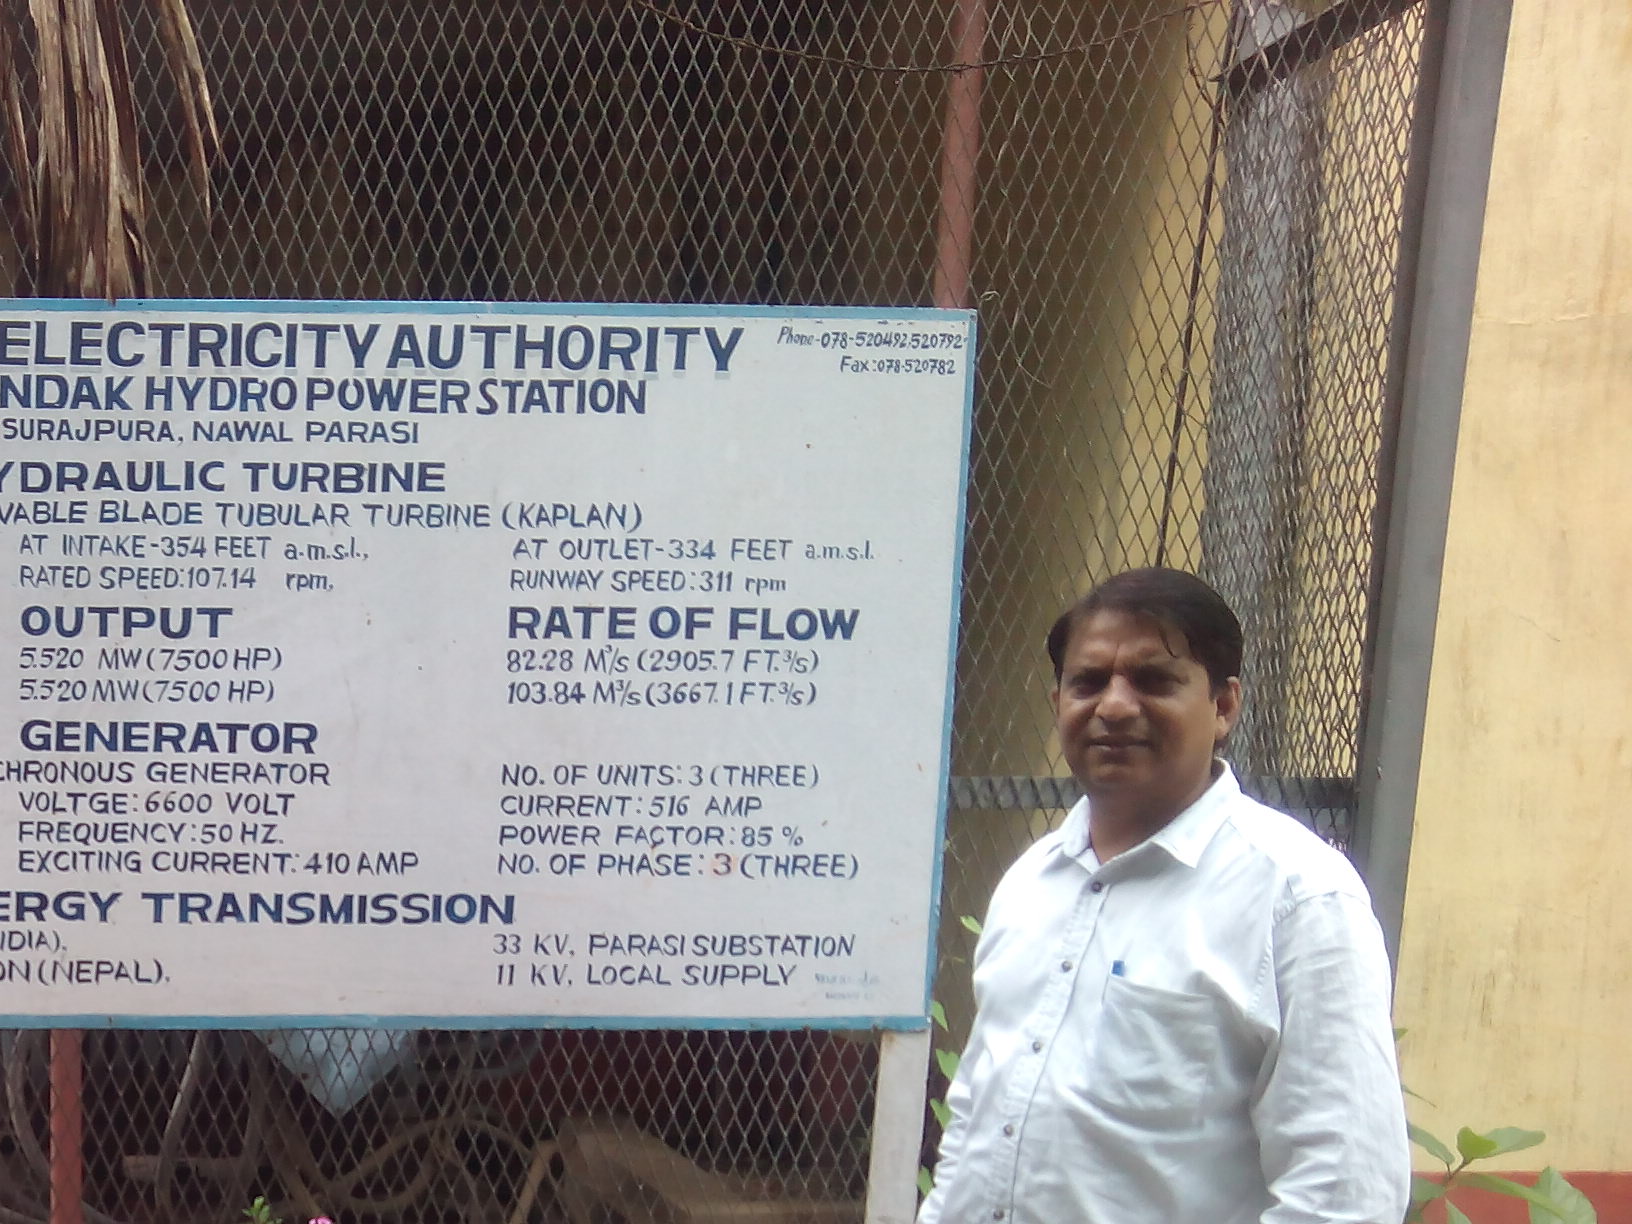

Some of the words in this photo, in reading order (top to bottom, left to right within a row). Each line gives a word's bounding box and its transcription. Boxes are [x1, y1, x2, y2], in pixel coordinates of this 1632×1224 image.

[386, 324, 745, 372] AUTHORITY
[145, 376, 297, 412] HYDRO
[306, 377, 471, 414] POWER
[475, 378, 647, 415] STATION
[192, 420, 294, 443] NAWAL
[306, 421, 419, 444] PARASI
[243, 462, 446, 494] TURBINE
[99, 500, 204, 526] BLADE
[215, 502, 351, 528] TUBULAR
[362, 502, 491, 529] TURBINE
[501, 501, 643, 533] (KAPLAN)
[19, 533, 48, 556] AT
[214, 536, 272, 560] FEET
[512, 538, 548, 561] AT
[730, 538, 794, 561] FEET
[19, 565, 92, 589] RATED
[509, 569, 605, 593] RUNWAY
[745, 575, 788, 597] rpm
[20, 605, 234, 640] OUTPUT
[508, 605, 639, 641] RATE
[648, 605, 715, 641] OF
[729, 607, 862, 641] FLOW
[506, 648, 574, 673] 82.28
[507, 680, 586, 705] 103.84
[19, 718, 320, 755] GENERATOR
[145, 761, 332, 787] GENERATOR
[500, 763, 546, 787] NO.
[553, 764, 590, 787] OF
[709, 764, 820, 789] (THREE)
[224, 792, 296, 818] VOLT
[704, 796, 764, 819] AMP
[498, 824, 602, 847] POWER
[18, 850, 143, 875] EXCITING
[356, 852, 420, 877] AMP
[497, 853, 541, 876] NO.
[549, 853, 587, 876] OF
[739, 853, 860, 880] (THREE)
[141, 891, 516, 926] TRANSMISSION
[493, 933, 522, 955] 33
[588, 934, 687, 957] PARASI
[691, 934, 857, 958] SUBSTATION
[495, 963, 516, 986] 11
[586, 964, 673, 987] LOCAL
[681, 964, 798, 987] SUPPLY
